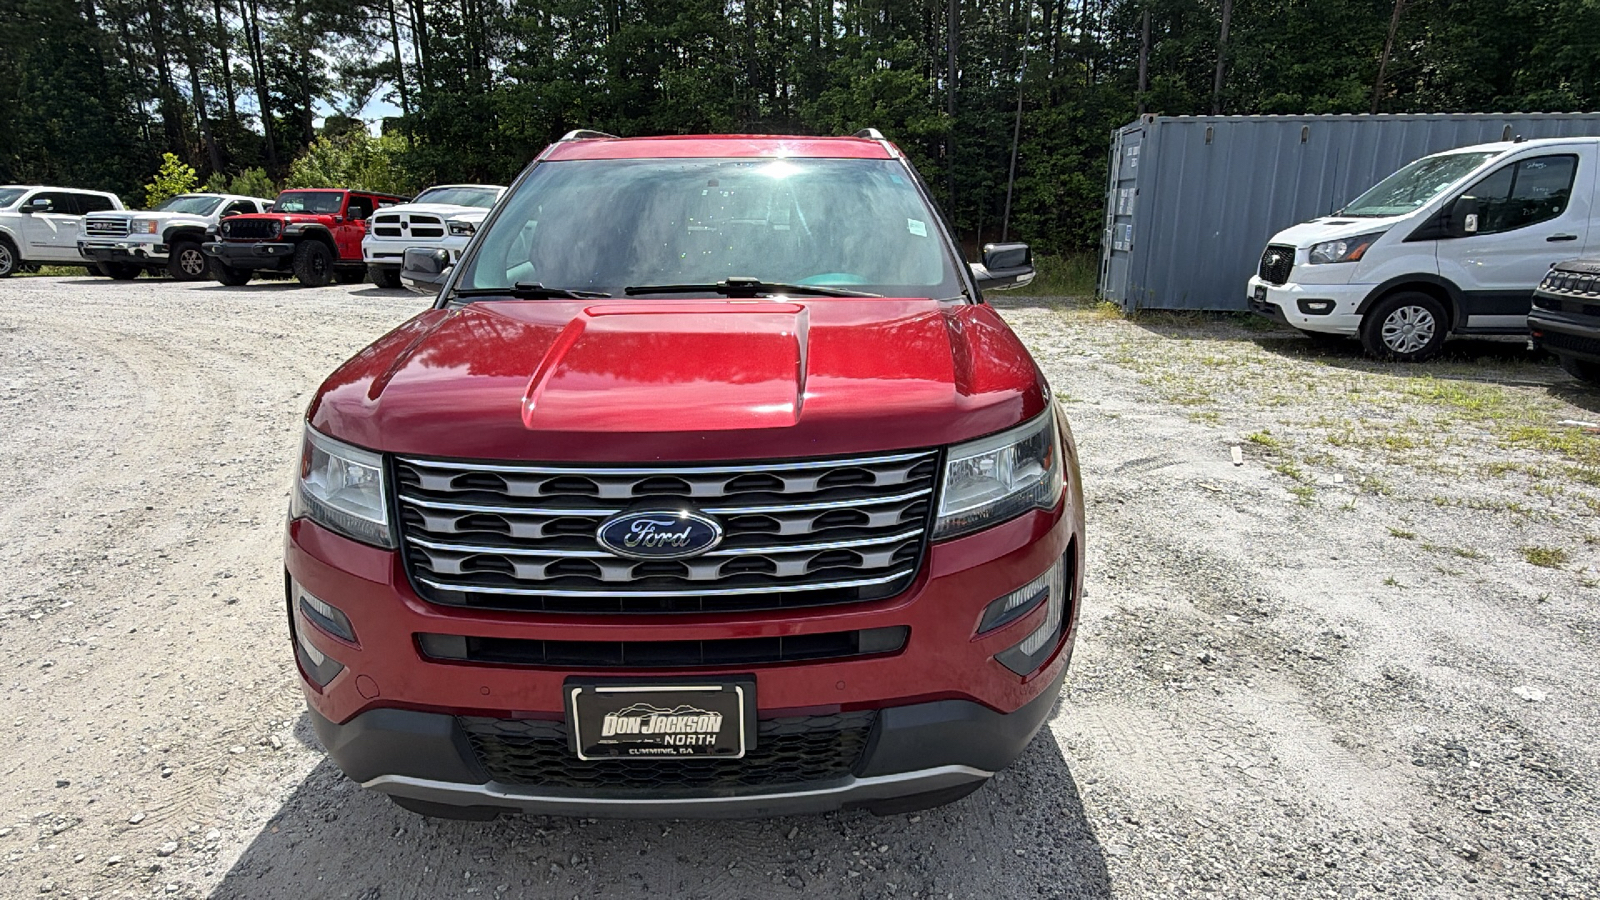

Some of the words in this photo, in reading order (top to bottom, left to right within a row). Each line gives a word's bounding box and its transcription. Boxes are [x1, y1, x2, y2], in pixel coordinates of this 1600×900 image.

[624, 519, 692, 548] Ford
[602, 715, 641, 736] DON
[641, 715, 723, 734] JACKSON
[664, 734, 717, 746] NORTH
